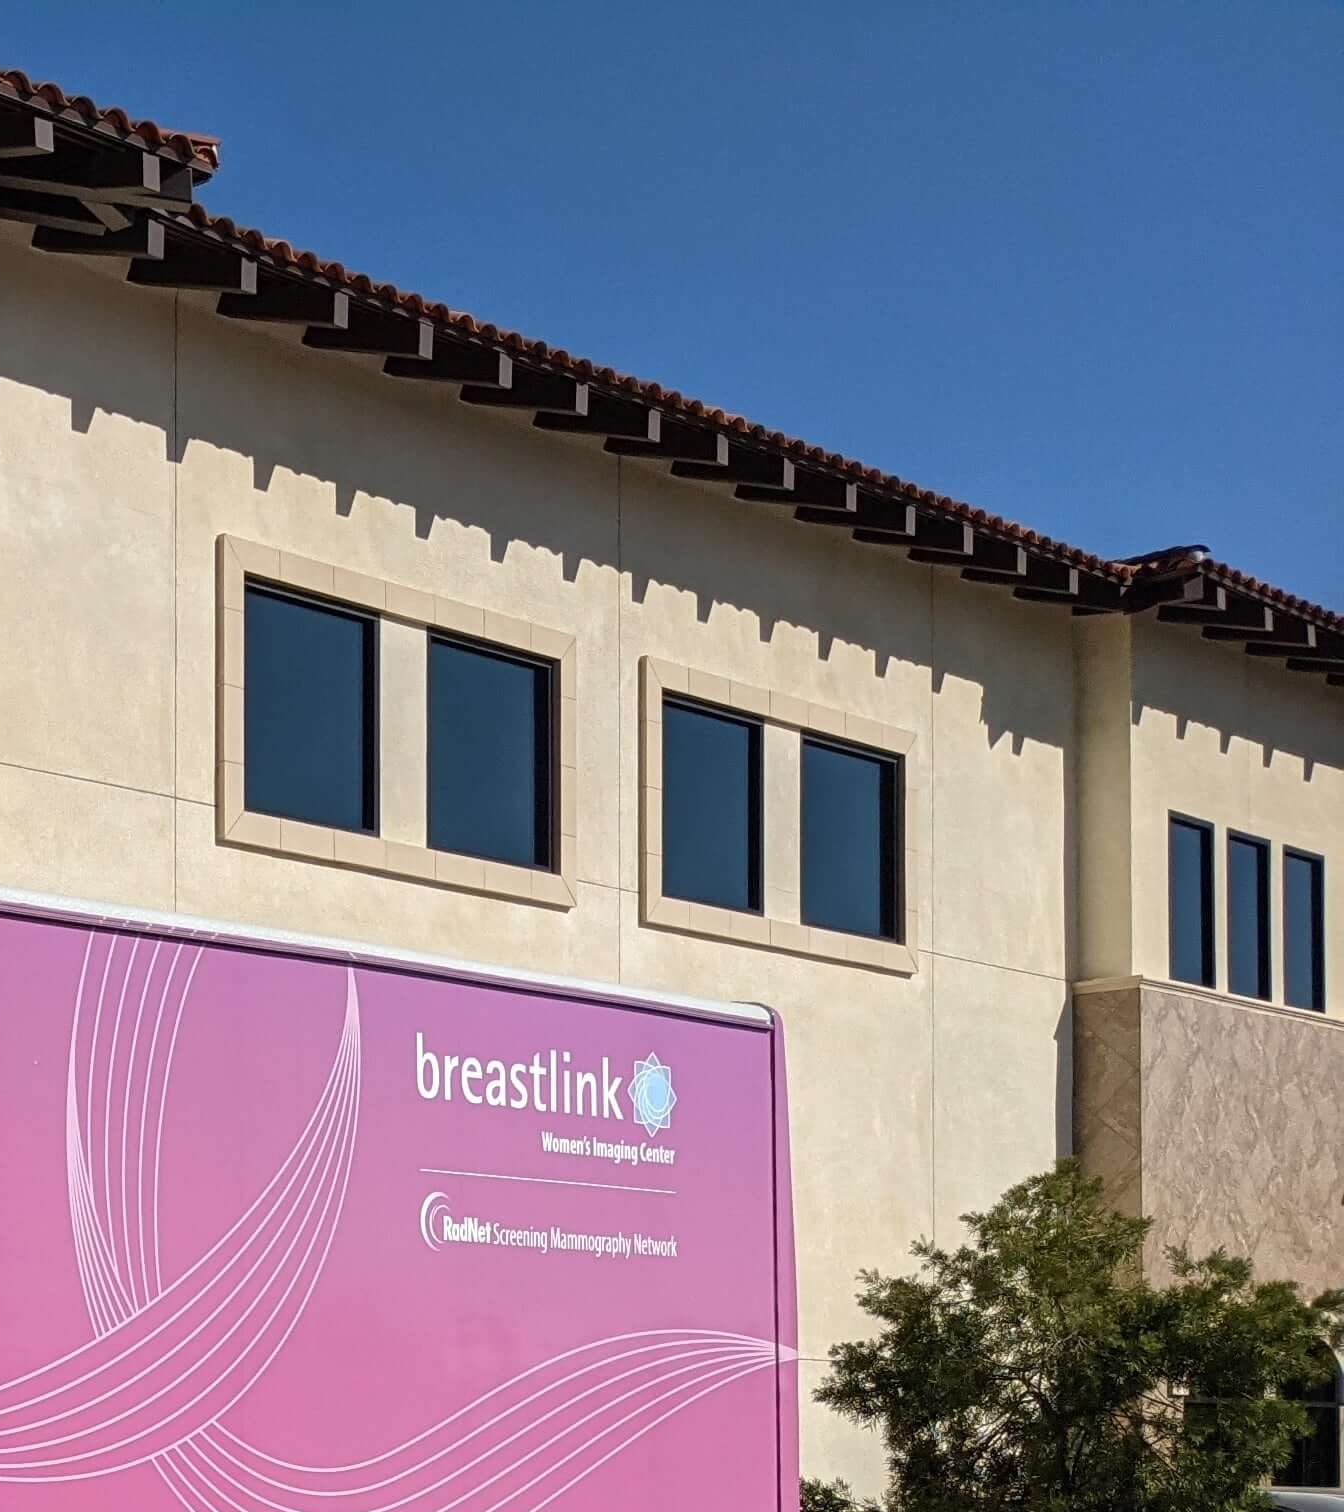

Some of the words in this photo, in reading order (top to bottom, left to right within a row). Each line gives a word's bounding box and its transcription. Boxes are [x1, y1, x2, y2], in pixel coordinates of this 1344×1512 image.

[416, 1032, 624, 1120] breastlink
[541, 1131, 591, 1155] Women's
[593, 1137, 638, 1165] Imaging
[640, 1142, 676, 1165] Center
[443, 1215, 492, 1244] RadNet
[493, 1223, 548, 1254] Screening
[550, 1227, 632, 1259] Mammography
[634, 1233, 678, 1257] Network
